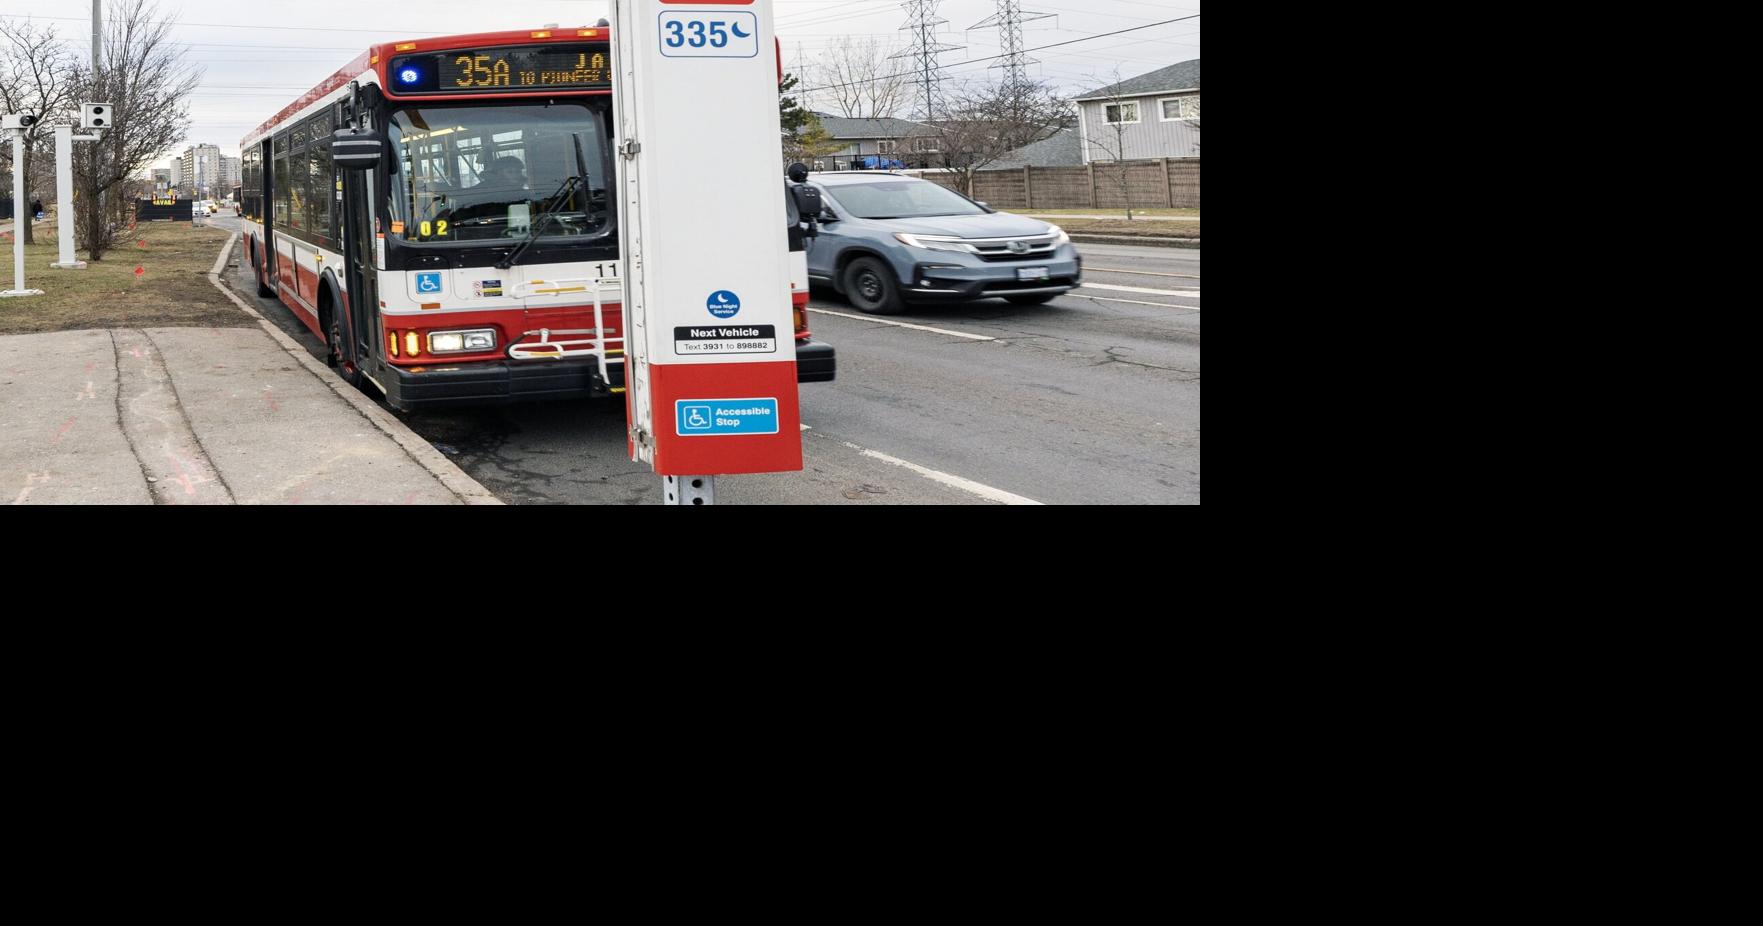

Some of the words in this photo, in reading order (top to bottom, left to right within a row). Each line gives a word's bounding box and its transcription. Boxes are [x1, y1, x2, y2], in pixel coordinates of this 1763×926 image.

[665, 20, 728, 48] 335
[455, 55, 510, 87] 35A
[520, 71, 535, 85] TO
[690, 328, 716, 338] Next
[718, 328, 759, 337] Vehicle
[684, 343, 701, 351] Text
[715, 407, 771, 416] Accessible
[716, 418, 740, 428] Stop
